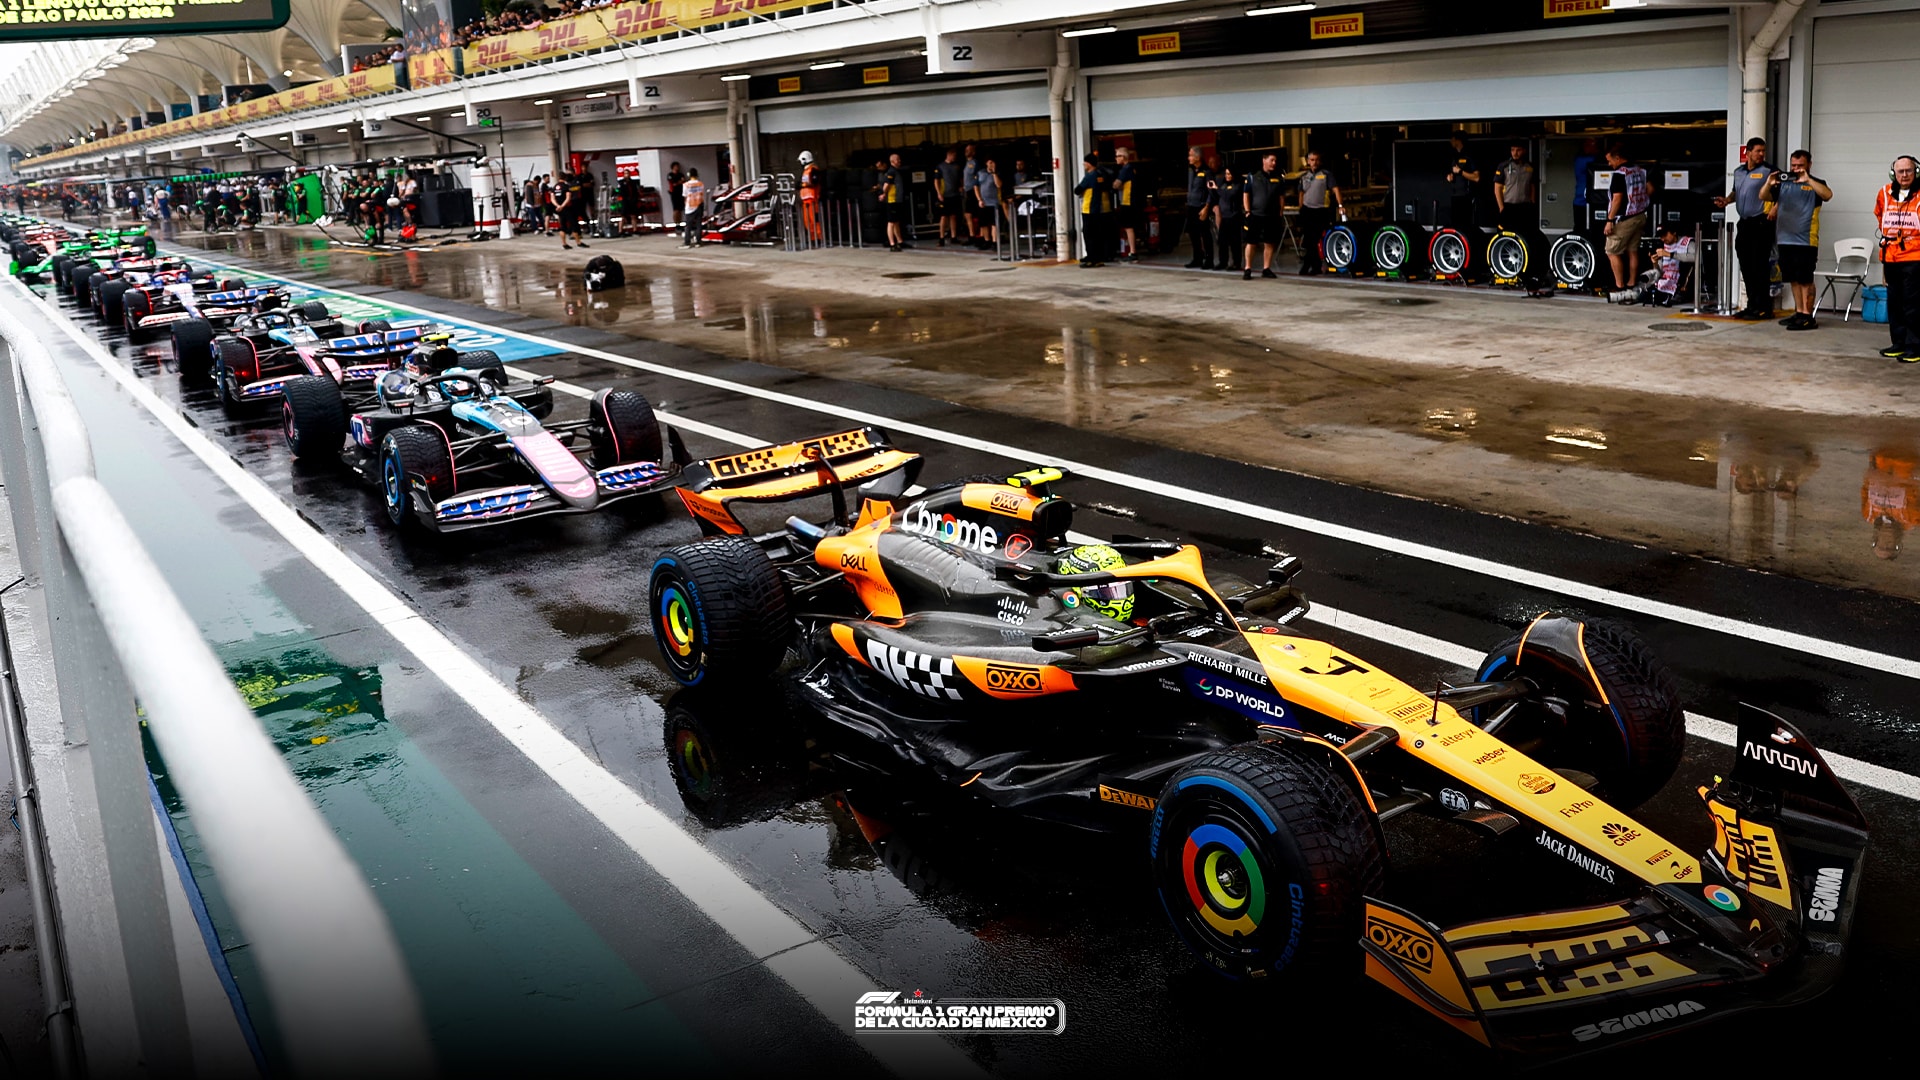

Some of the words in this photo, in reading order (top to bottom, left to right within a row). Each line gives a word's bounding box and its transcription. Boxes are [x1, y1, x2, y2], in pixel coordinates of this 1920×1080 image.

[63, 7, 126, 21] PAULO
[127, 5, 175, 19] 2024
[614, 1, 669, 37] DHL
[1314, 17, 1359, 35] PIRELLI
[537, 22, 579, 54] DHL
[1141, 36, 1176, 51] PIRELLI
[476, 38, 512, 66] DHL
[952, 46, 973, 61] 22
[644, 86, 661, 97] 21
[477, 108, 491, 118] 20
[371, 123, 381, 131] 19
[500, 415, 534, 429] 10
[992, 493, 1021, 509] OXXO
[900, 501, 998, 554] Chrome
[840, 553, 868, 572] DELL
[1123, 656, 1177, 672] vmware
[1188, 651, 1233, 674] RICHARD
[1235, 667, 1268, 686] MILLE
[987, 669, 1041, 689] OXXO
[1215, 685, 1234, 700] DP
[1236, 692, 1285, 718] WORLD
[1439, 728, 1477, 747] alteryx
[1473, 747, 1508, 765] webex
[1743, 741, 1818, 778] ARROW
[1100, 788, 1156, 811] DEWAL
[1559, 800, 1594, 818] FxPro
[1535, 830, 1566, 858] JACK
[1613, 829, 1642, 847] CNBC
[1645, 849, 1673, 866] PIRELLI
[1808, 867, 1844, 922] SENNA
[1369, 924, 1433, 965] OXXO
[1570, 999, 1706, 1042] SENNA
